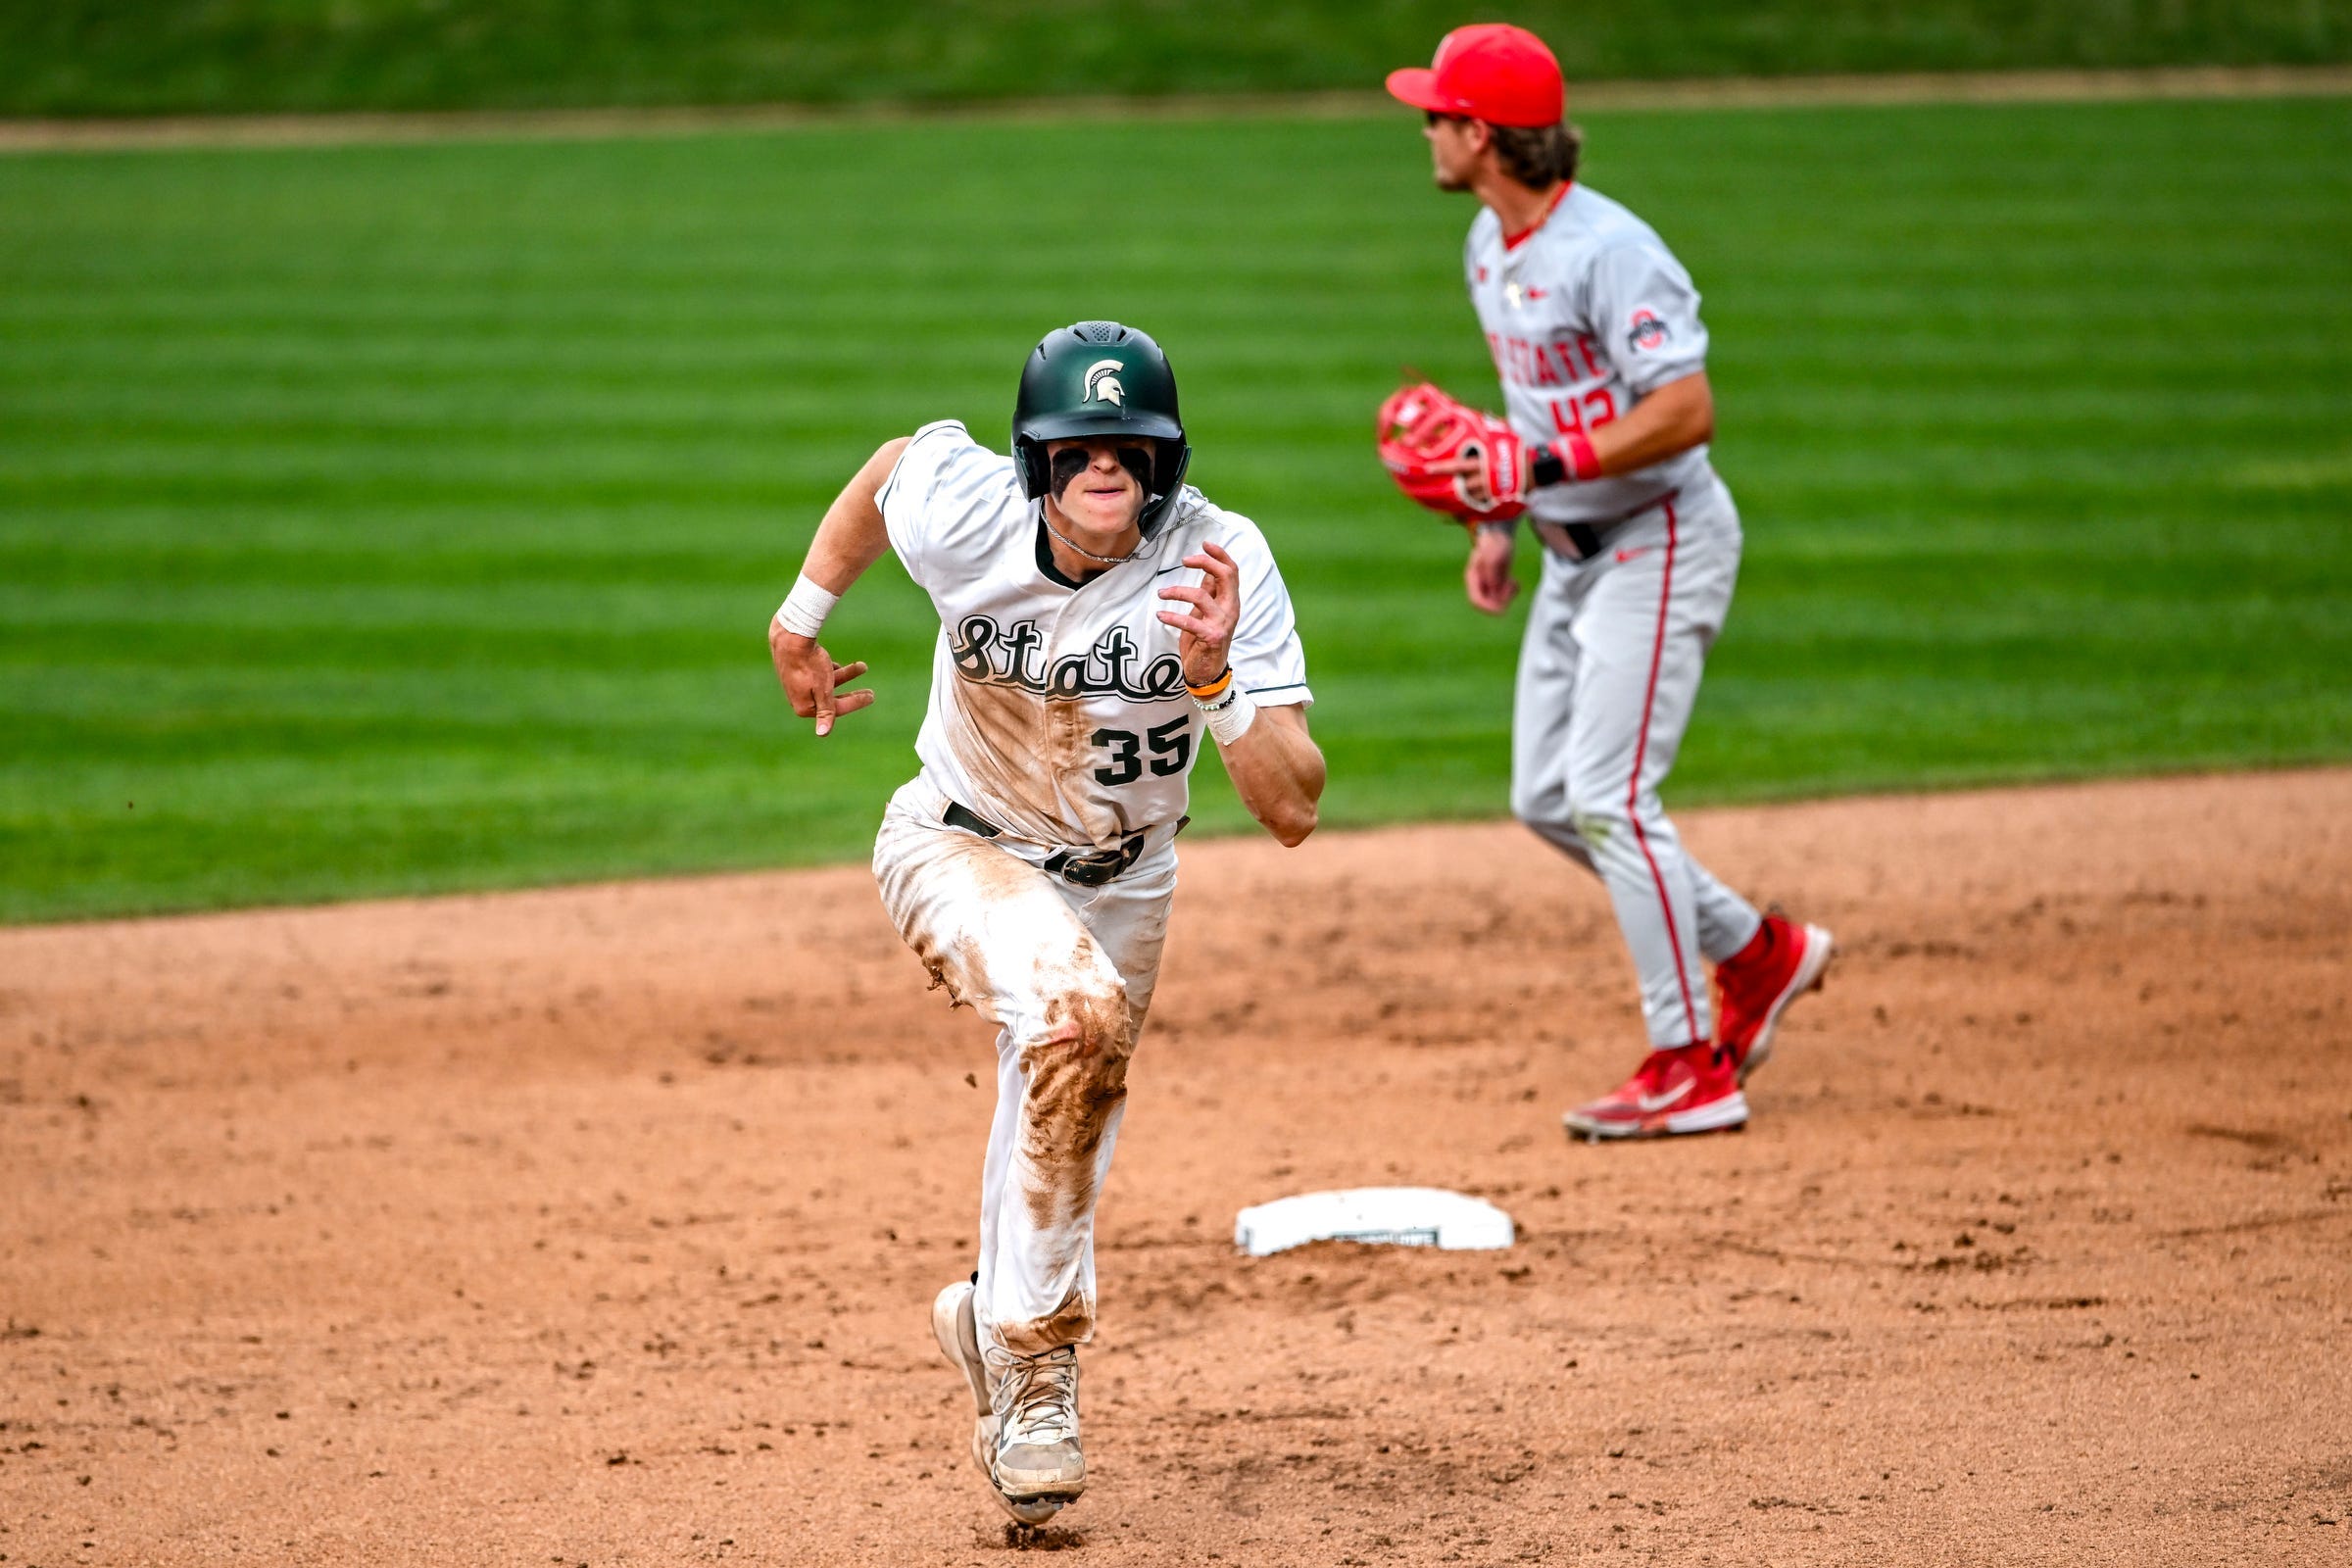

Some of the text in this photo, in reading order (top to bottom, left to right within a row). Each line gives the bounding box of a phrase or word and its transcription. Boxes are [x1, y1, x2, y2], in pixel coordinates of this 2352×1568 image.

[1549, 387, 1617, 435] 42
[948, 614, 1188, 704] State
[1091, 714, 1191, 786] 35
